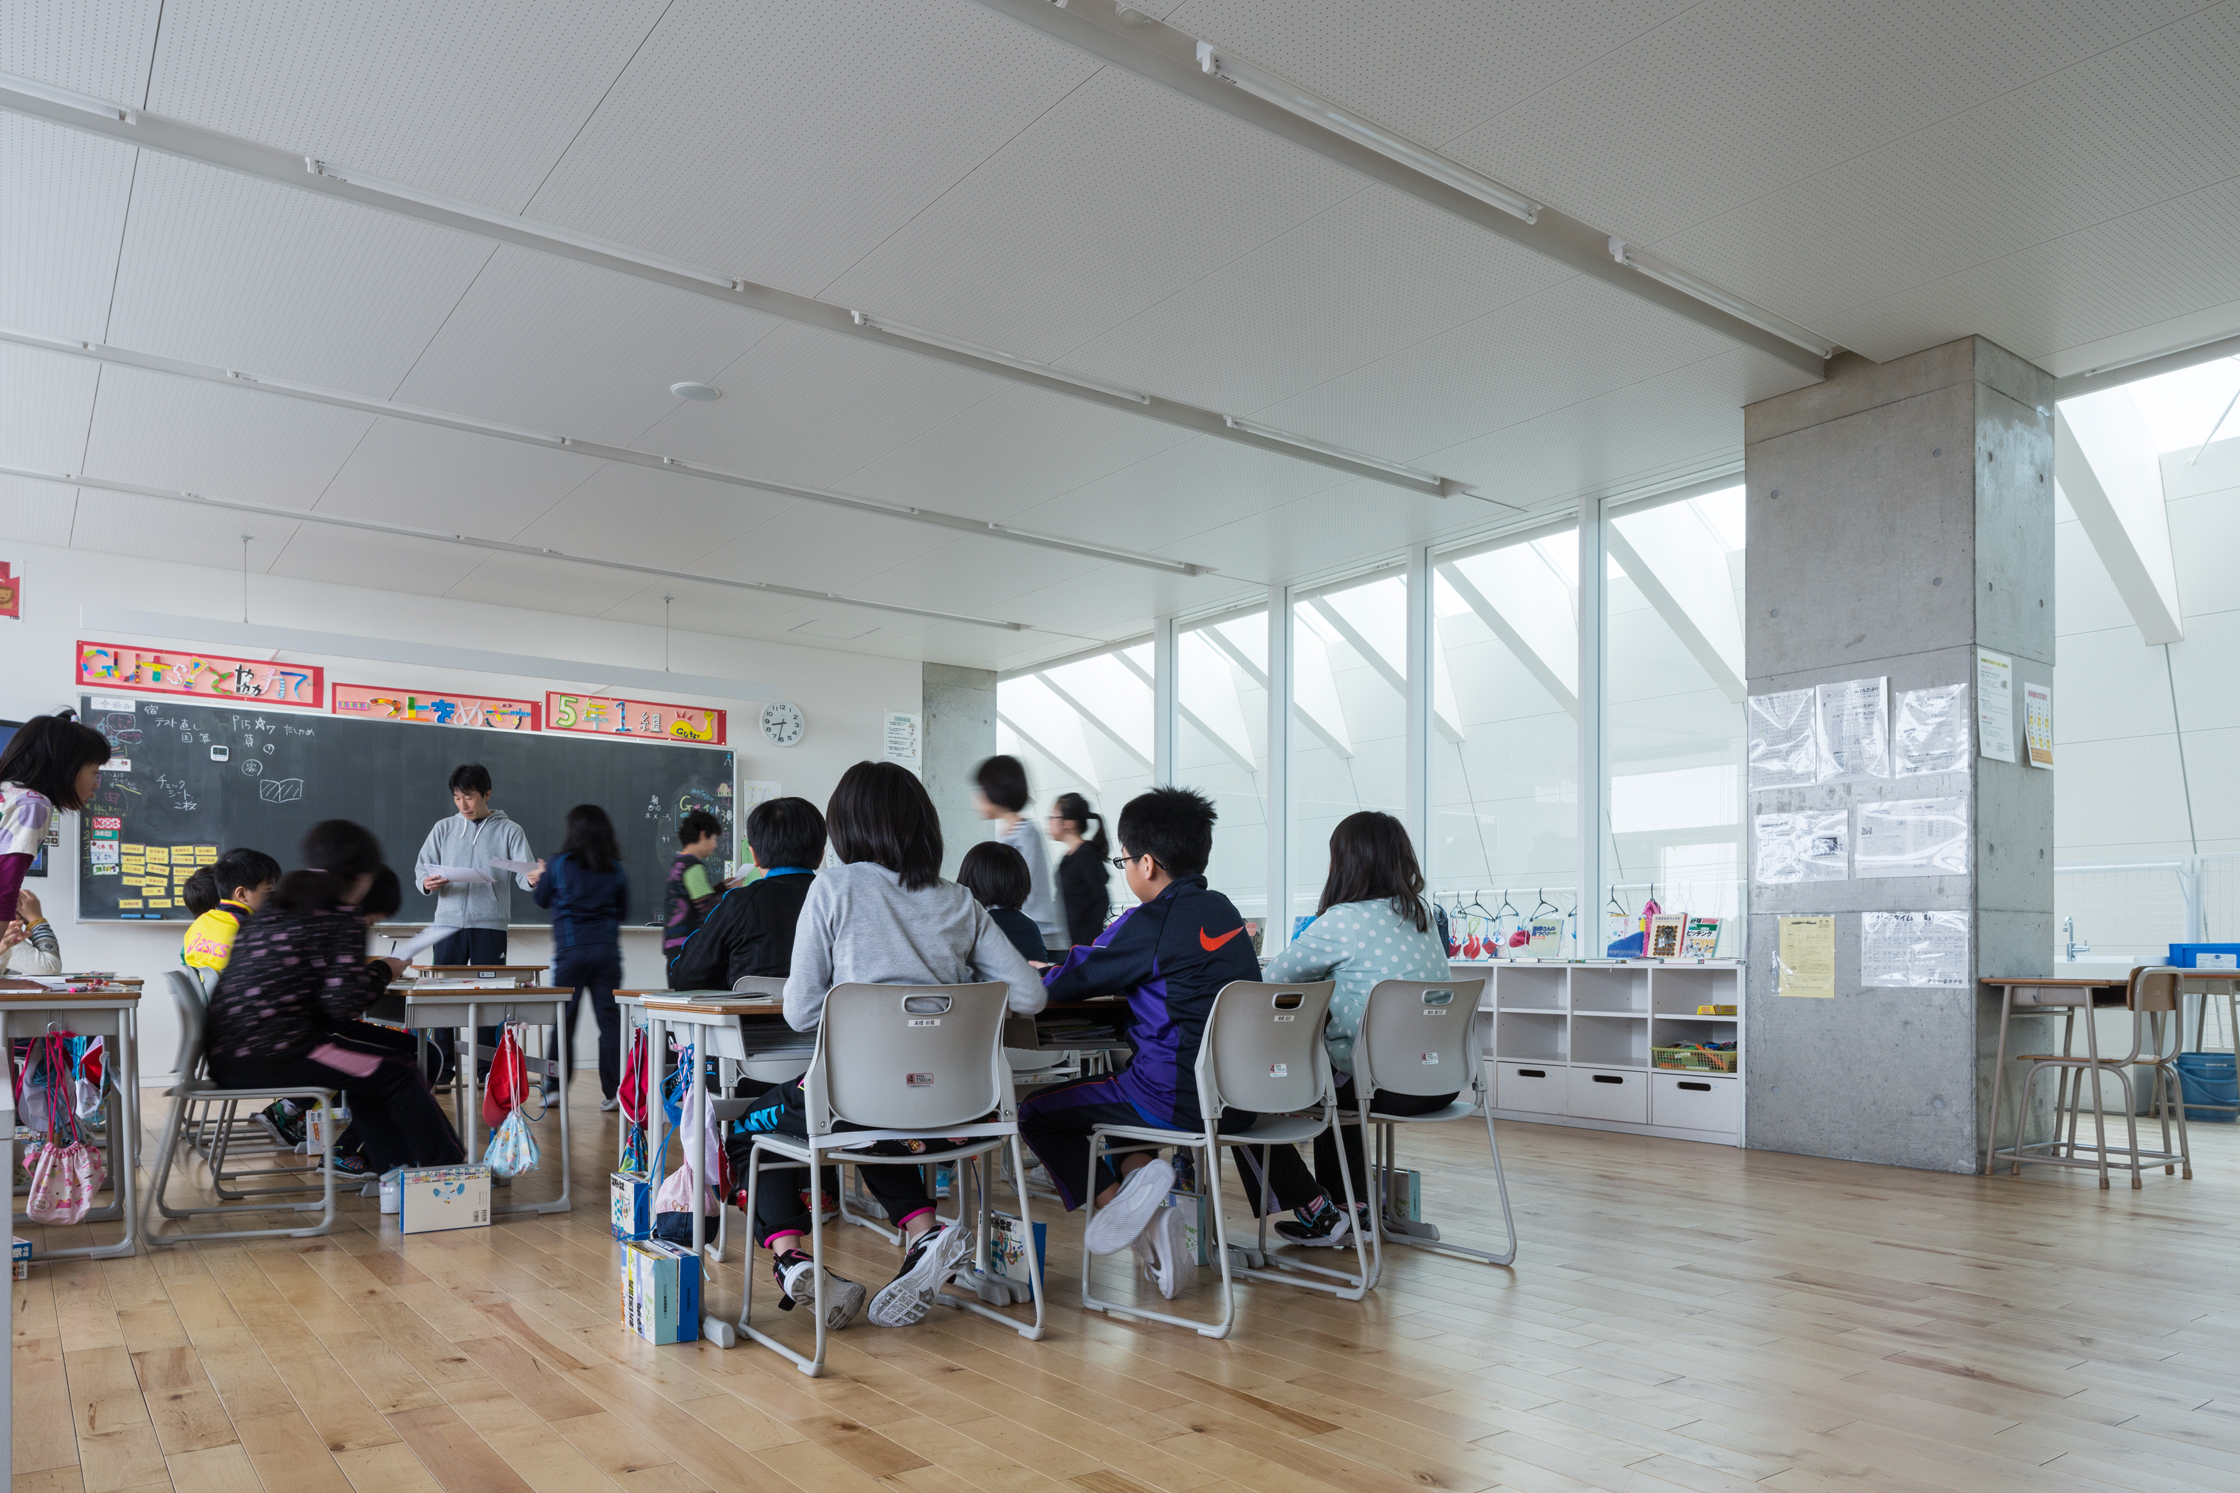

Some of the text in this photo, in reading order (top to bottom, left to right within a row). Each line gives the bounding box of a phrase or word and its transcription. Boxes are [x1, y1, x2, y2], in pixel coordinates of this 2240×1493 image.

[556, 695, 663, 733] 5年1組
[194, 938, 229, 958] asics
[908, 1075, 914, 1083] 4
